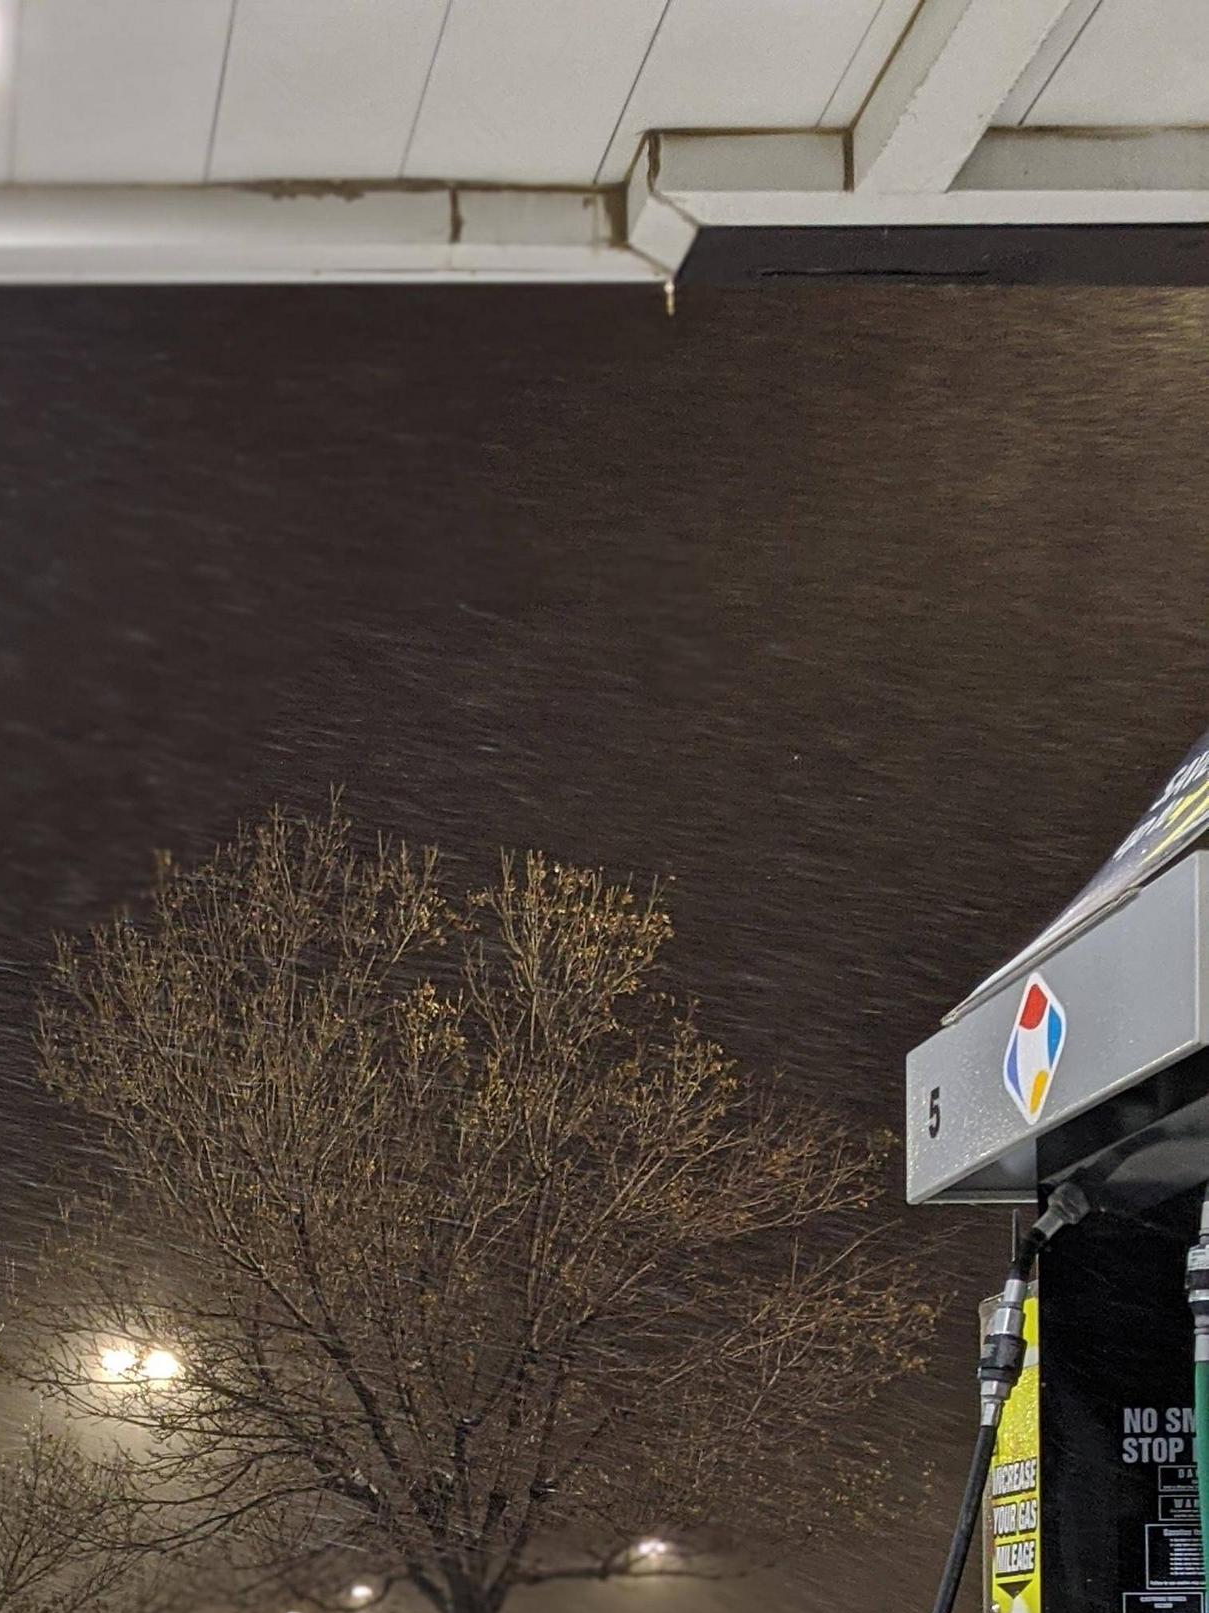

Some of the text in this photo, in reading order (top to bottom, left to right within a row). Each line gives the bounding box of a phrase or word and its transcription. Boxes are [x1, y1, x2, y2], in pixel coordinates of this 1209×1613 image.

[928, 1086, 940, 1139] 5
[1123, 1407, 1158, 1434] NO
[1122, 1437, 1185, 1464] STOP
[993, 1498, 1038, 1536] YOUR GAS
[996, 1540, 1036, 1575] MILEAGE
